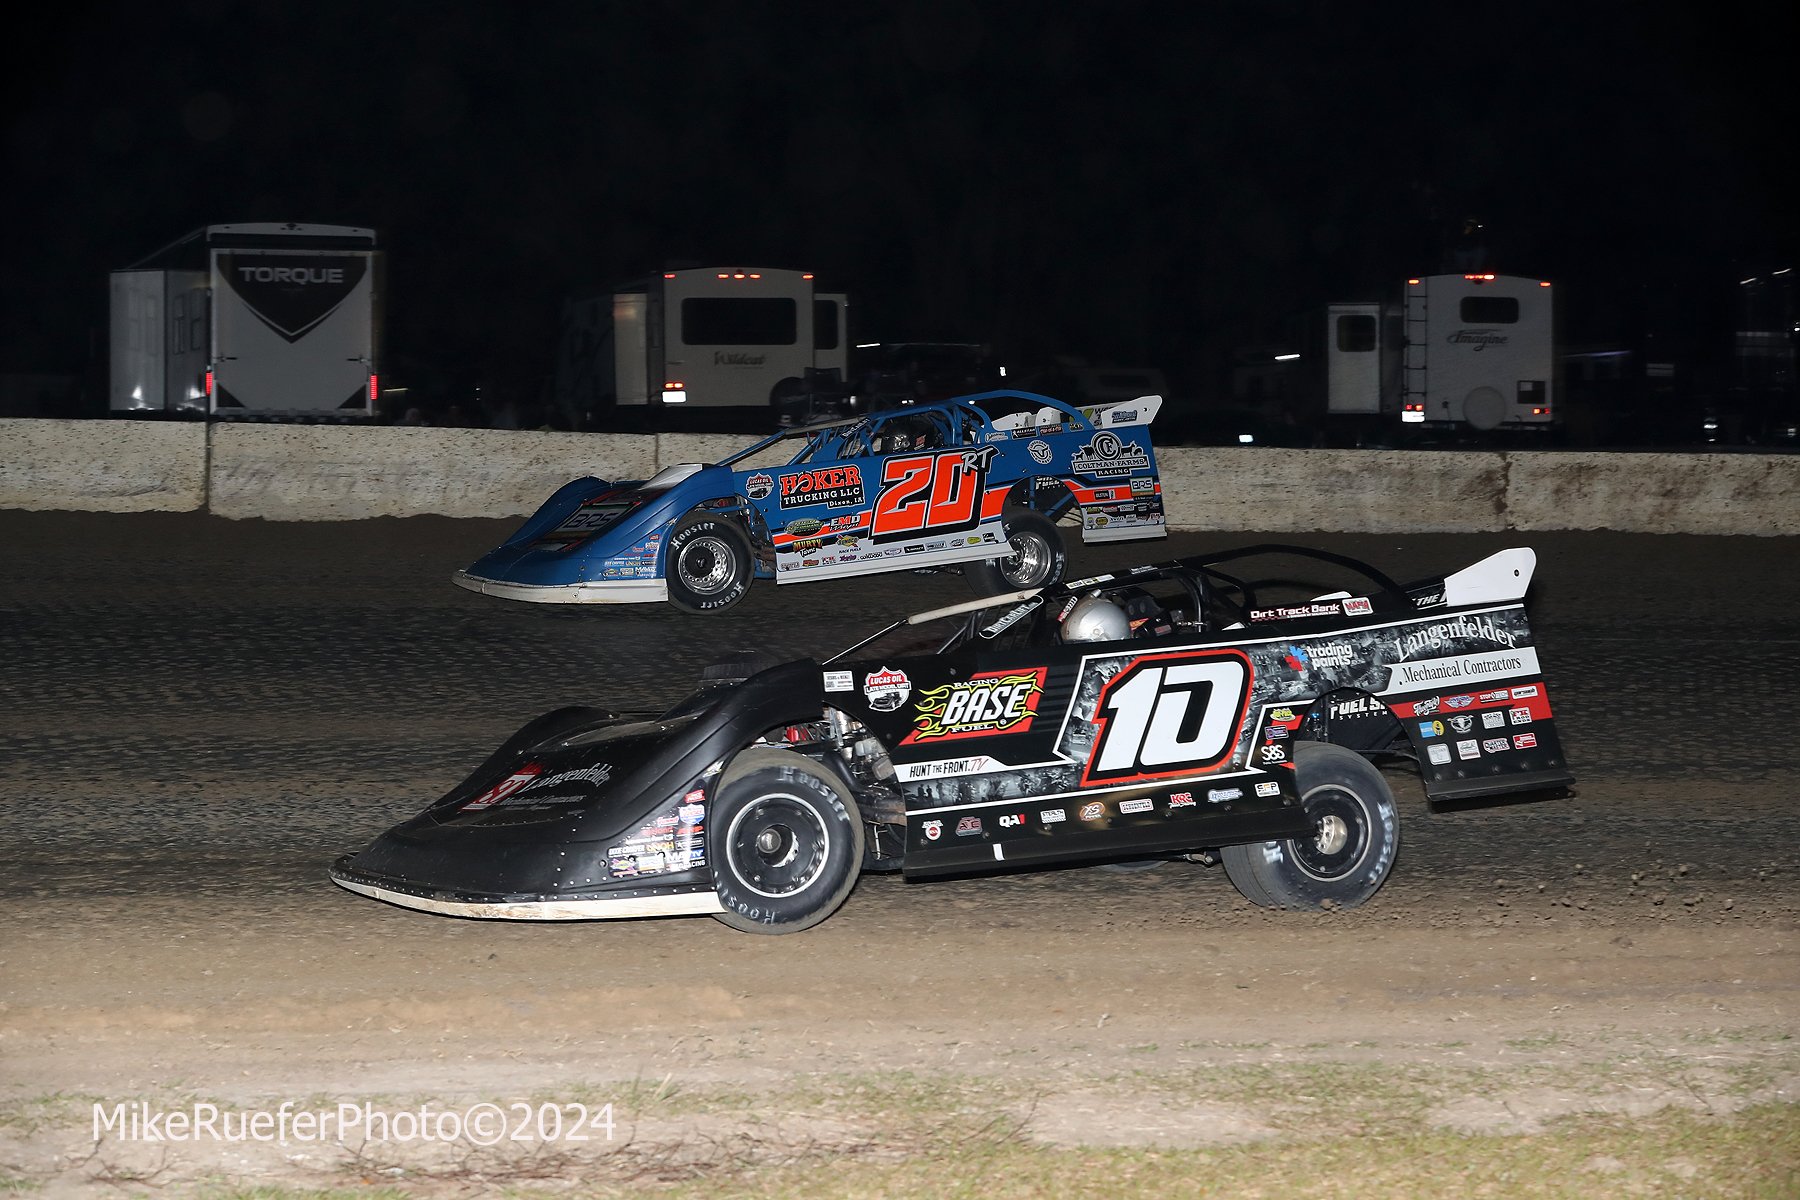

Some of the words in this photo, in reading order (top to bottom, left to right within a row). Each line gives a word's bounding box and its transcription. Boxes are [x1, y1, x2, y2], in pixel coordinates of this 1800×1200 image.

[238, 267, 344, 285] TORQUE
[1446, 329, 1509, 352] Imagine
[713, 350, 767, 367] Wildcat
[961, 446, 995, 473] RT
[1097, 468, 1130, 476] RACING
[781, 467, 860, 496] HOKER
[784, 490, 838, 505] TRUCKING
[840, 487, 861, 498] LLC
[872, 454, 979, 536] 20
[830, 515, 861, 527] EMD
[670, 522, 716, 551] Hoosier
[793, 540, 822, 552] MURTY
[700, 580, 746, 610] Hoosier
[1416, 593, 1440, 606] THE
[1250, 609, 1276, 620] Dirt
[1276, 606, 1310, 617] Track
[1311, 603, 1341, 613] Bank
[1394, 615, 1517, 662] Langenfelder
[1306, 642, 1353, 659] trading
[1311, 654, 1352, 670] paints
[1402, 662, 1462, 683] Mechanical
[1463, 656, 1522, 676] Contractors
[870, 676, 891, 685] LUCAS
[891, 675, 903, 683] OIL
[953, 677, 999, 689] RACING
[940, 683, 1033, 725] BASE
[1096, 661, 1244, 772] 10
[951, 722, 994, 733] FUEL
[1260, 744, 1286, 761] S&S
[909, 763, 931, 778] HUNT
[932, 764, 943, 773] THE
[776, 765, 850, 822] Hoosier
[1170, 792, 1193, 804] KRC
[1083, 804, 1100, 816] XS
[1000, 813, 1026, 828] QA1
